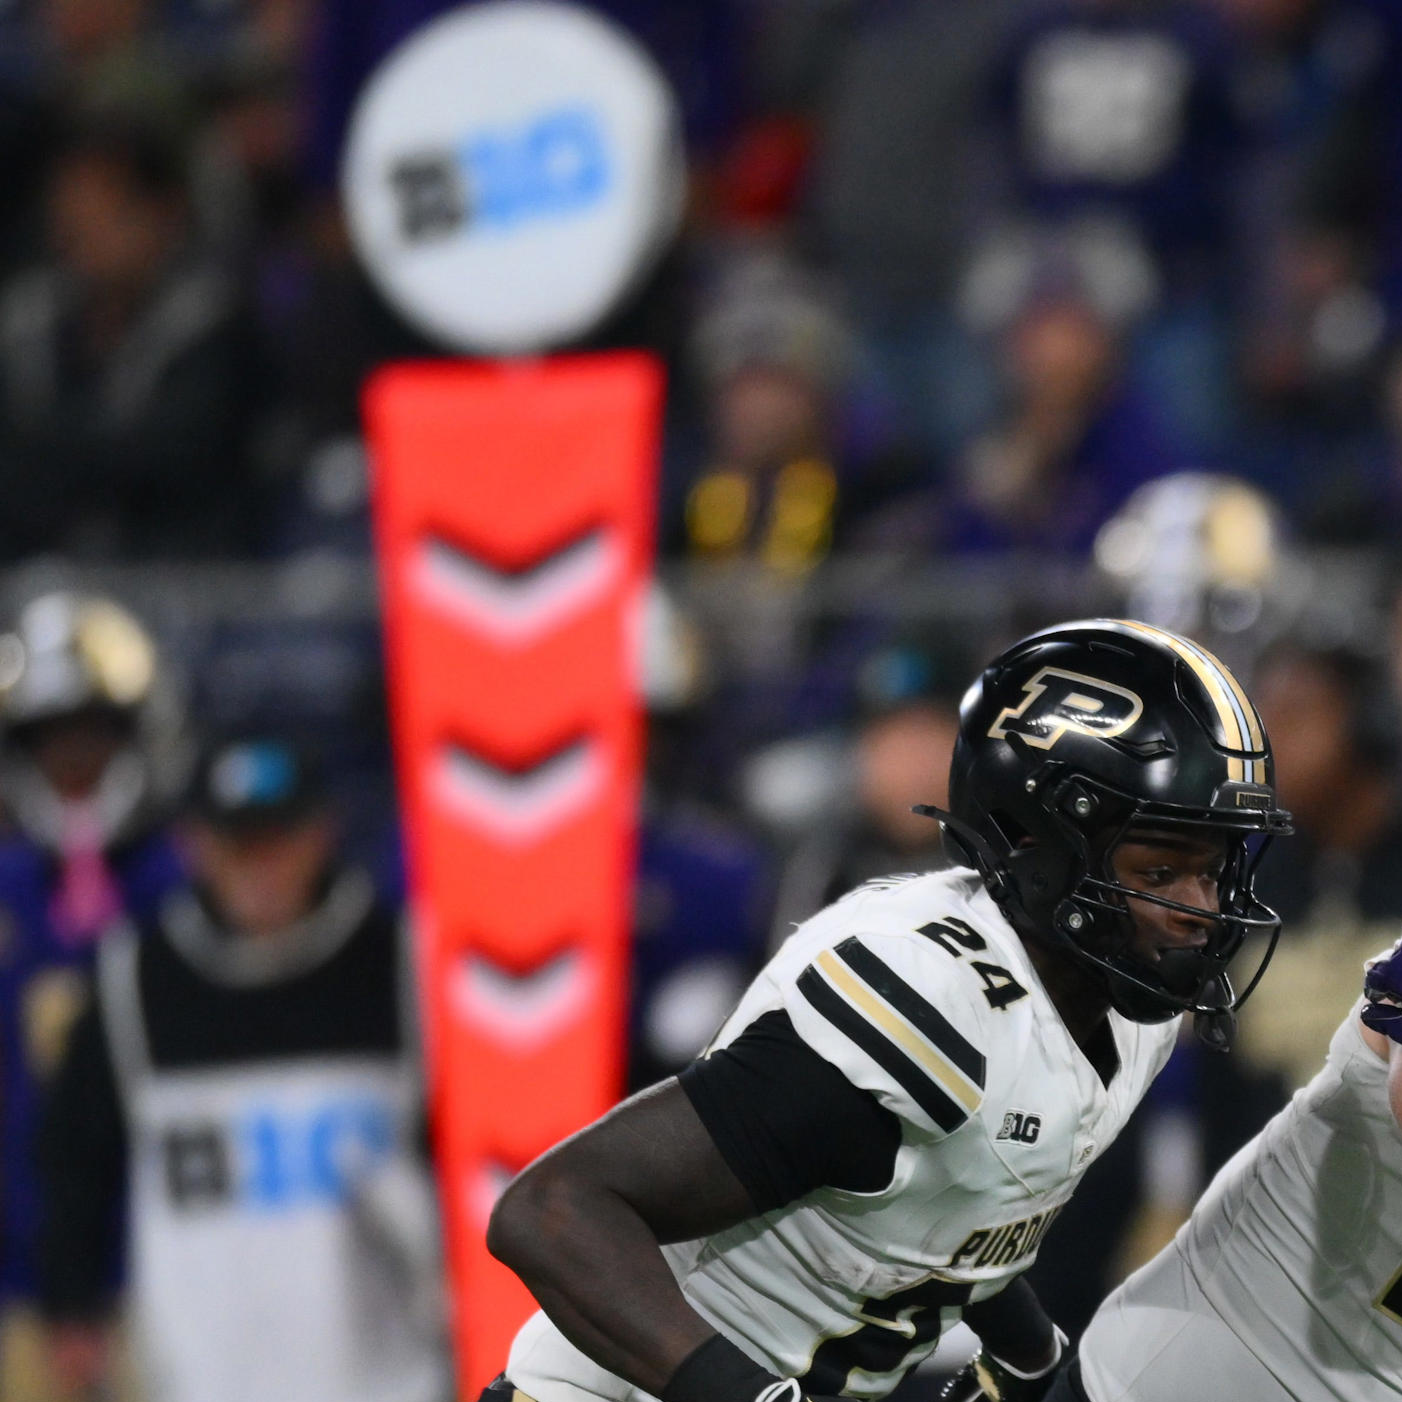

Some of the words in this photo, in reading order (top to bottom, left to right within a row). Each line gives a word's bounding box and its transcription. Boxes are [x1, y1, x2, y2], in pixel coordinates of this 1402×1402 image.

[987, 666, 1144, 750] P
[915, 916, 1029, 1011] 24
[995, 1111, 1042, 1145] B1G
